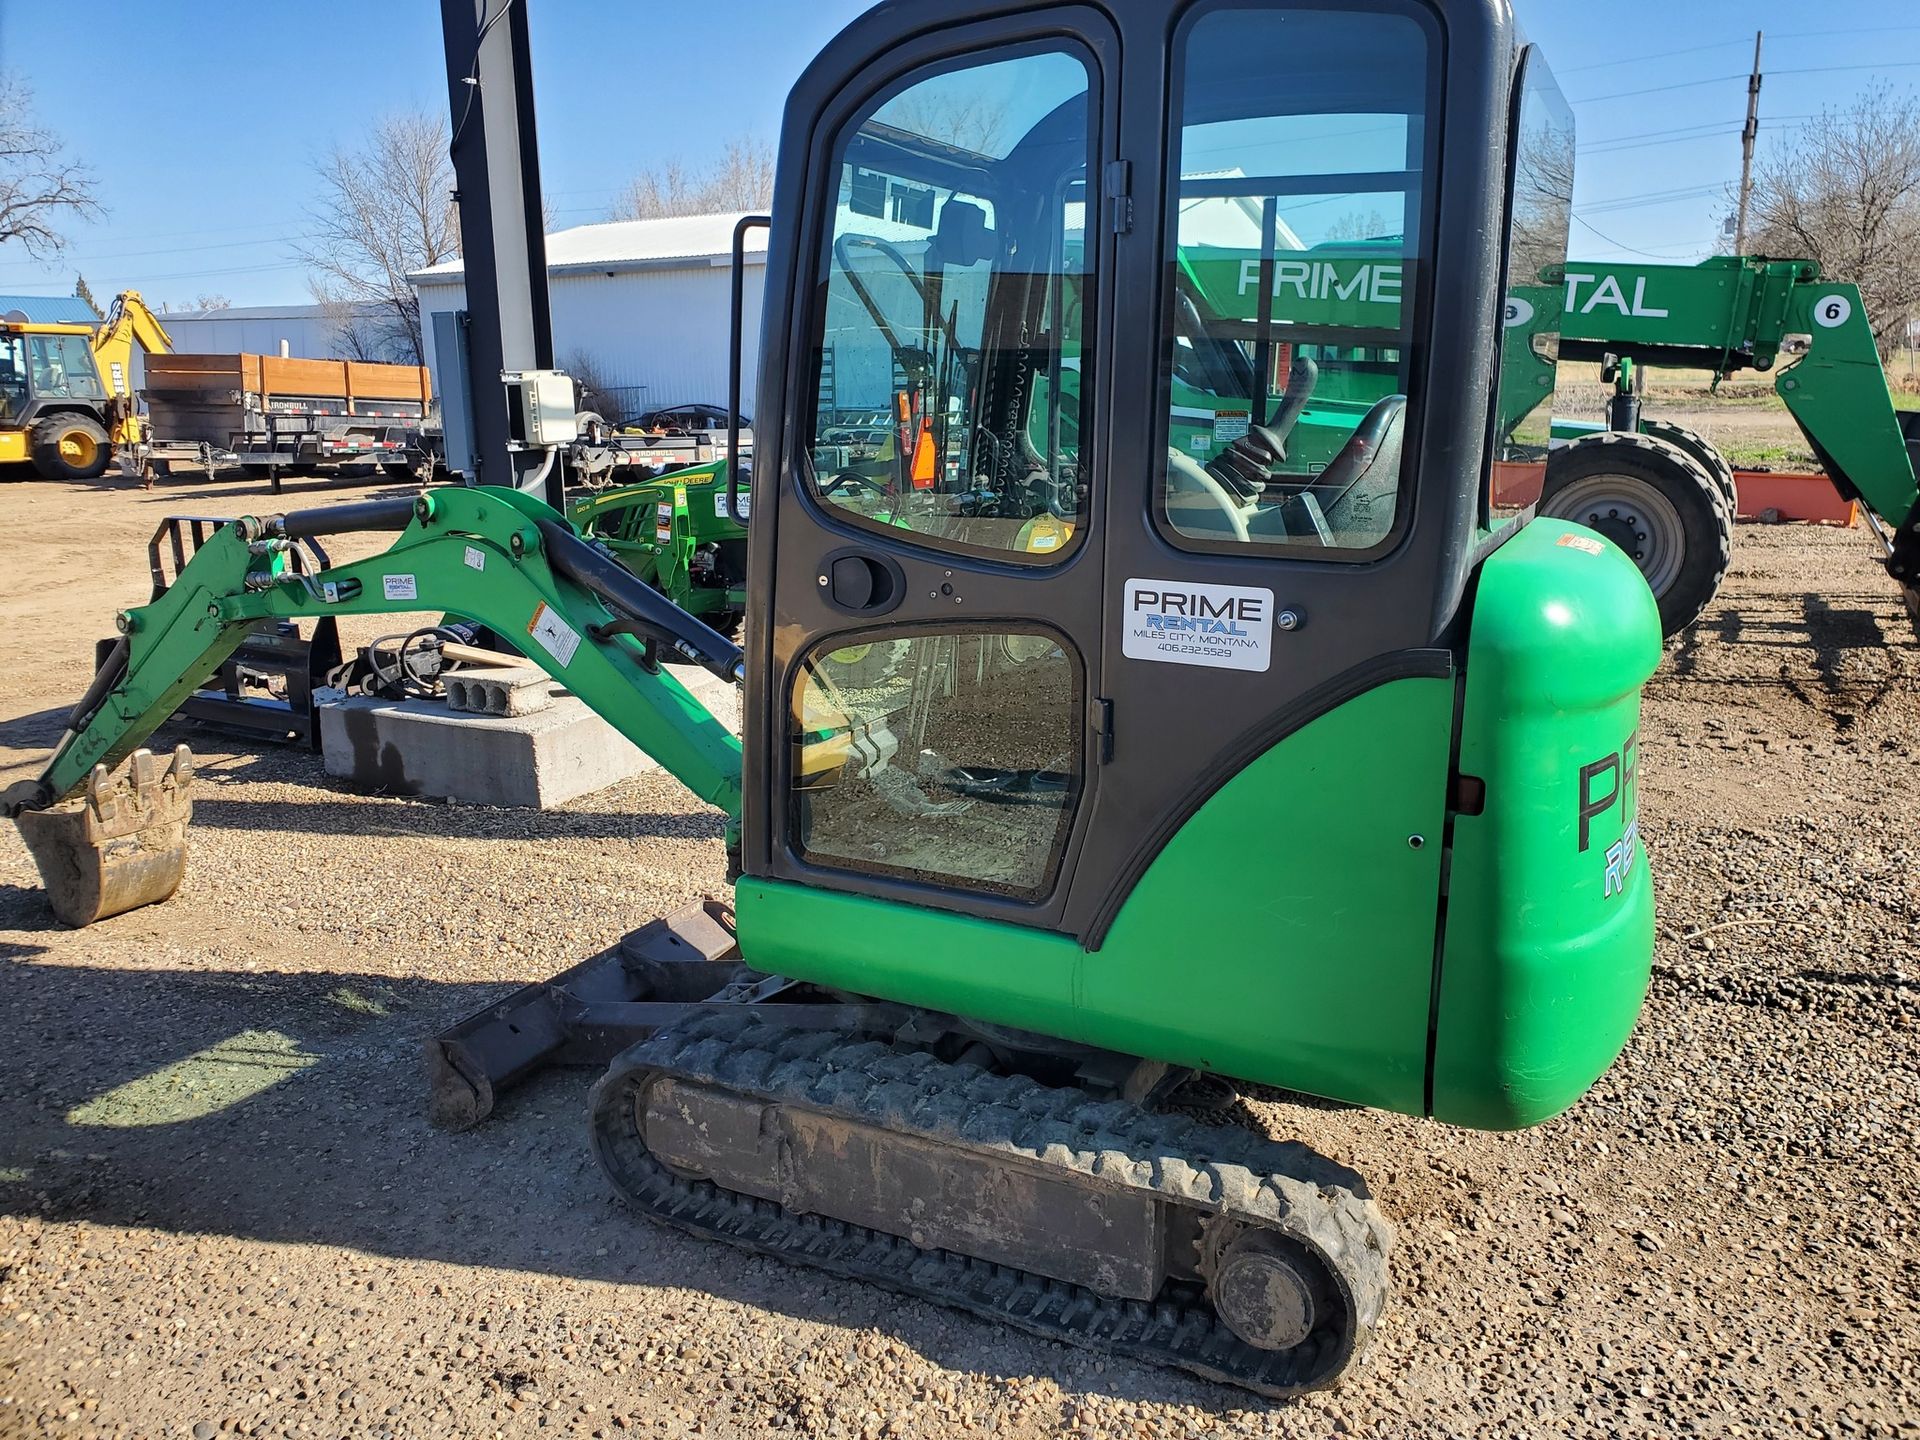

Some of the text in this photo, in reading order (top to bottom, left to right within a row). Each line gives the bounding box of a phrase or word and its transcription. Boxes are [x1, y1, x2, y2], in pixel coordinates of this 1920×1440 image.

[1238, 259, 1402, 304] PRIME
[1824, 303, 1841, 319] 6
[111, 363, 125, 394] EERE
[270, 401, 308, 410] IRONBULL
[683, 476, 710, 485] DEERE
[1134, 590, 1263, 622] PRIME
[1146, 614, 1247, 636] RENTAL
[1133, 629, 1166, 640] MILES
[1199, 635, 1259, 649] MONTANA
[1157, 643, 1232, 658] 406.232.5529
